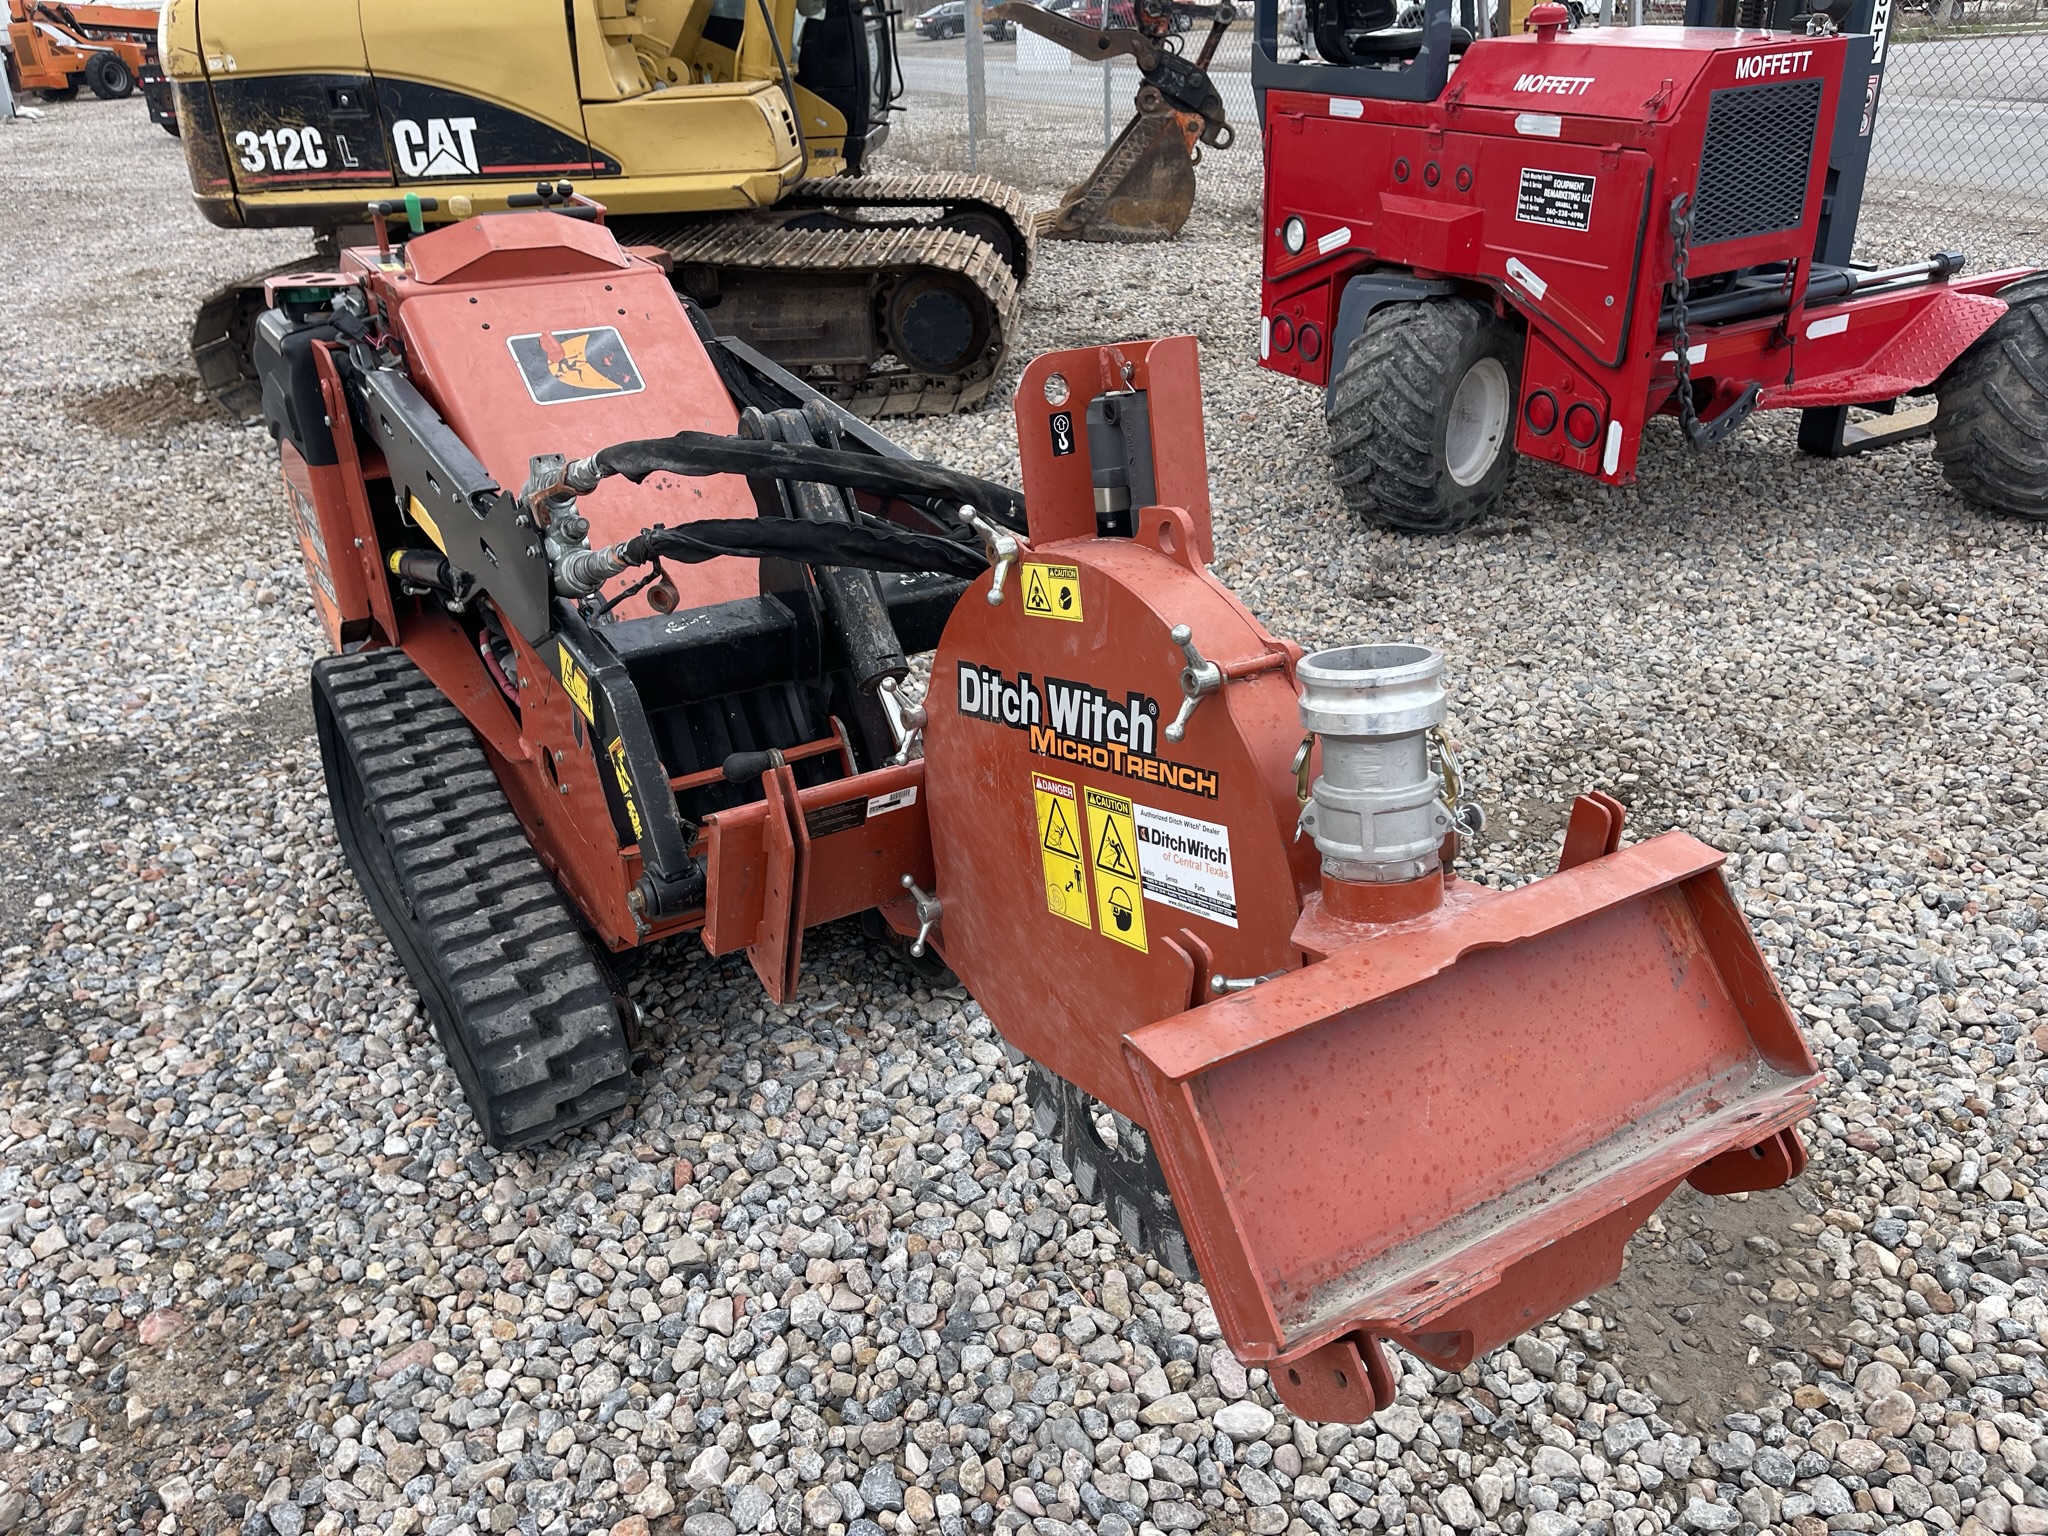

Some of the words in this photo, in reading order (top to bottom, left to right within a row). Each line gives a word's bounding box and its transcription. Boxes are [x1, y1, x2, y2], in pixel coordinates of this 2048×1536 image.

[1735, 50, 1813, 80] MOFFETT
[1513, 73, 1595, 96] MOFFETT
[235, 125, 328, 173] 312C
[335, 134, 359, 168] L
[392, 117, 480, 177] CAT
[1544, 188, 1580, 202] REMARKETING
[1582, 193, 1592, 203] LLC
[1554, 179, 1585, 192] EQUIPMENT
[1054, 569, 1076, 578] CAUTION
[960, 667, 1041, 725] Ditch
[1042, 781, 1074, 799] DANGER
[1096, 795, 1129, 814] CAUTION
[1140, 809, 1168, 822] Authorized
[1169, 817, 1183, 826] Ditch
[1202, 825, 1220, 835] Dealer
[1163, 852, 1171, 861] of
[1173, 854, 1202, 871] Central
[1205, 863, 1229, 879] Texas
